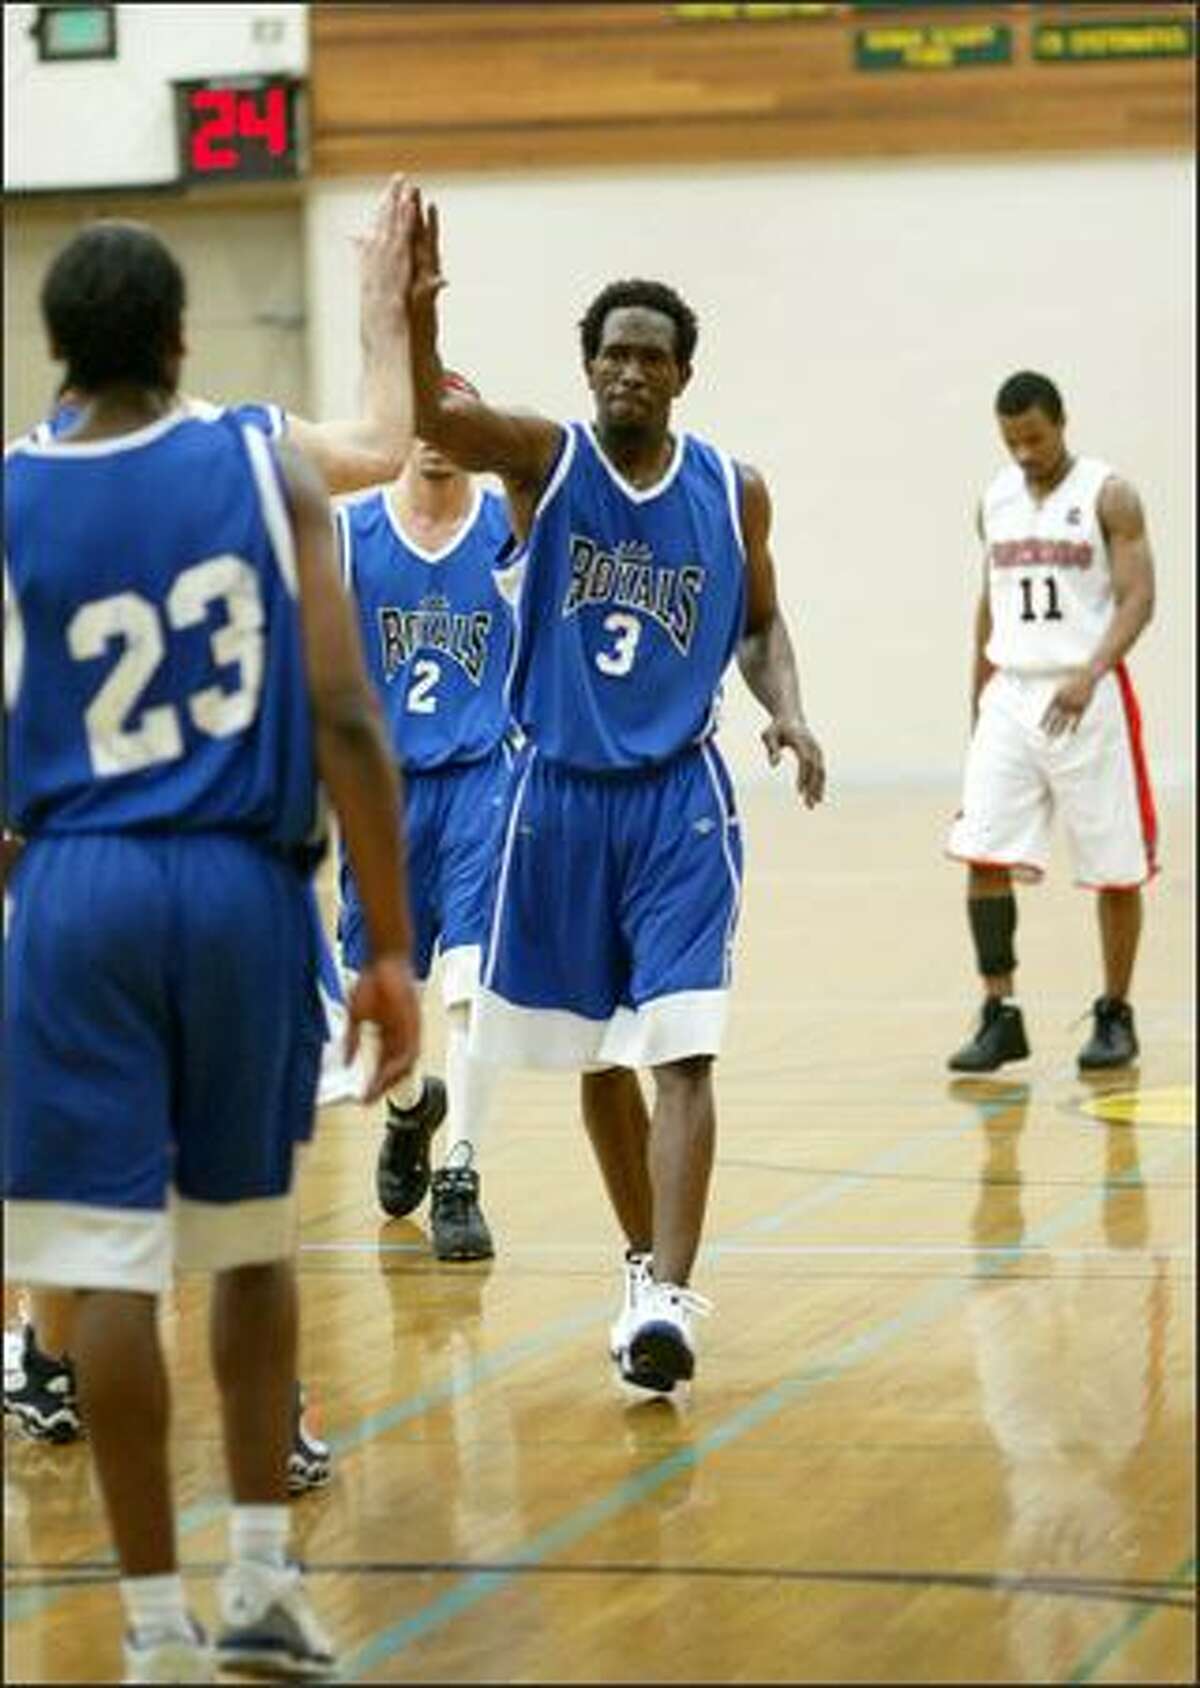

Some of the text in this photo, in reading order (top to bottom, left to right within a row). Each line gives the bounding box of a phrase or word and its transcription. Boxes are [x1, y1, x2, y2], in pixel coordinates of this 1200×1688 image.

[190, 88, 286, 169] 24
[562, 535, 705, 656] ROYALS
[1020, 575, 1063, 621] 11
[67, 553, 265, 777] 23
[595, 612, 642, 675] 3
[407, 660, 440, 713] 2
